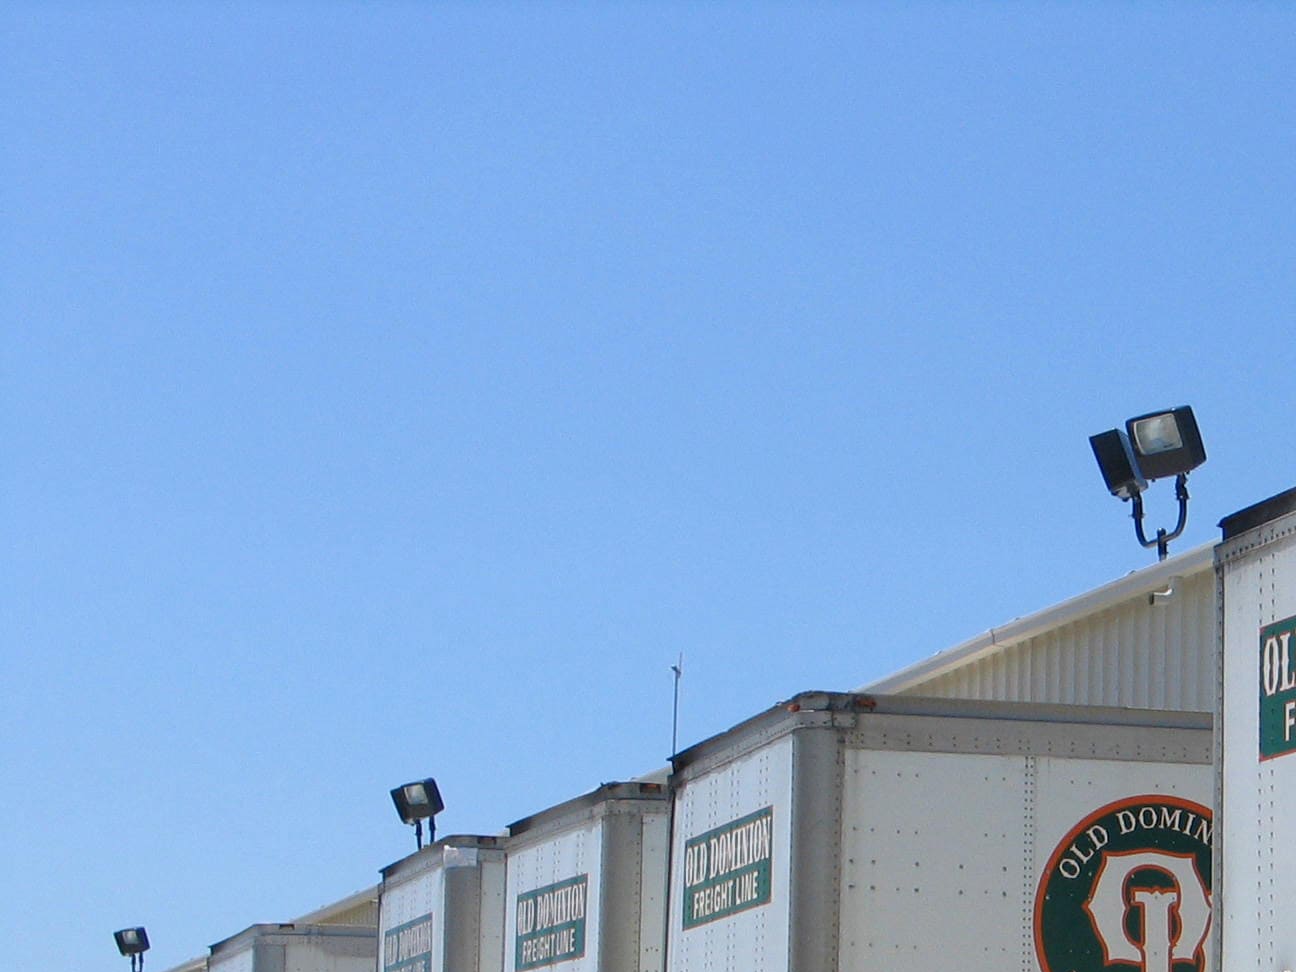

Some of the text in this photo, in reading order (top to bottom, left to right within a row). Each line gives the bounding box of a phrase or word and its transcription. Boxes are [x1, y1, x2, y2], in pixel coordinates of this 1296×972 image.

[686, 816, 771, 887] OLD DOMINION
[1059, 824, 1109, 879] OLD
[536, 883, 586, 931] DOMINION
[693, 871, 758, 919] FREIGHT LINE
